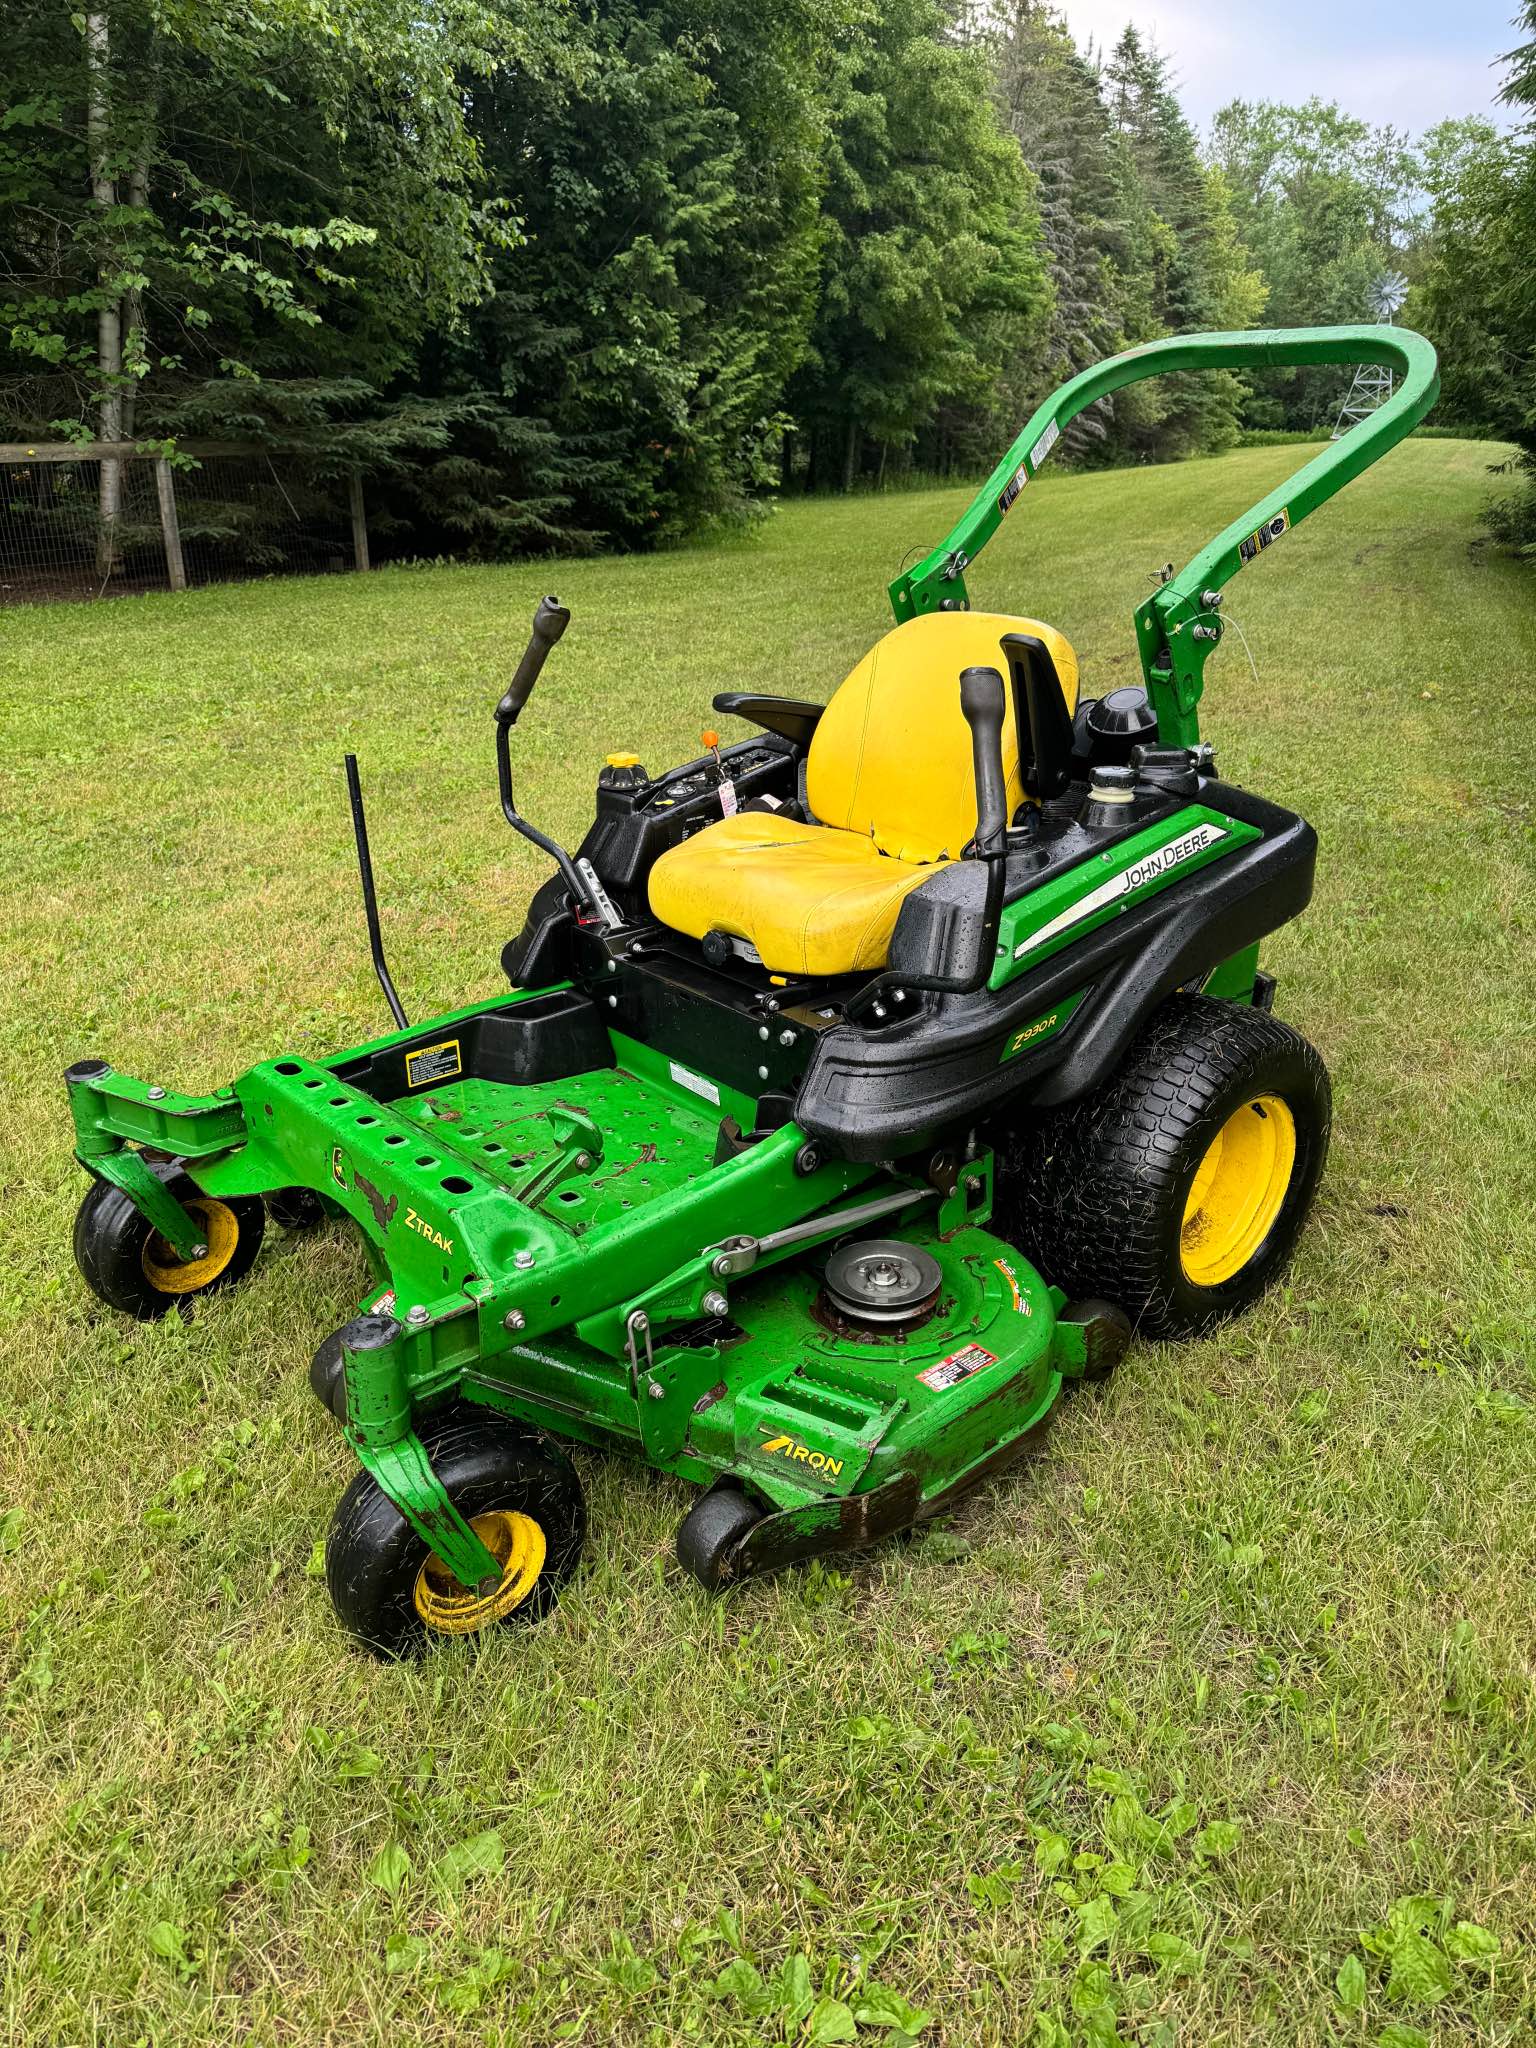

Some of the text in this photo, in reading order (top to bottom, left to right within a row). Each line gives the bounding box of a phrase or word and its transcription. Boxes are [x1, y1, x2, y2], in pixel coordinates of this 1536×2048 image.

[1123, 830, 1210, 892] JOHN DEERE
[1011, 1014, 1058, 1052] Z930R
[404, 1207, 454, 1256] ZTRAK
